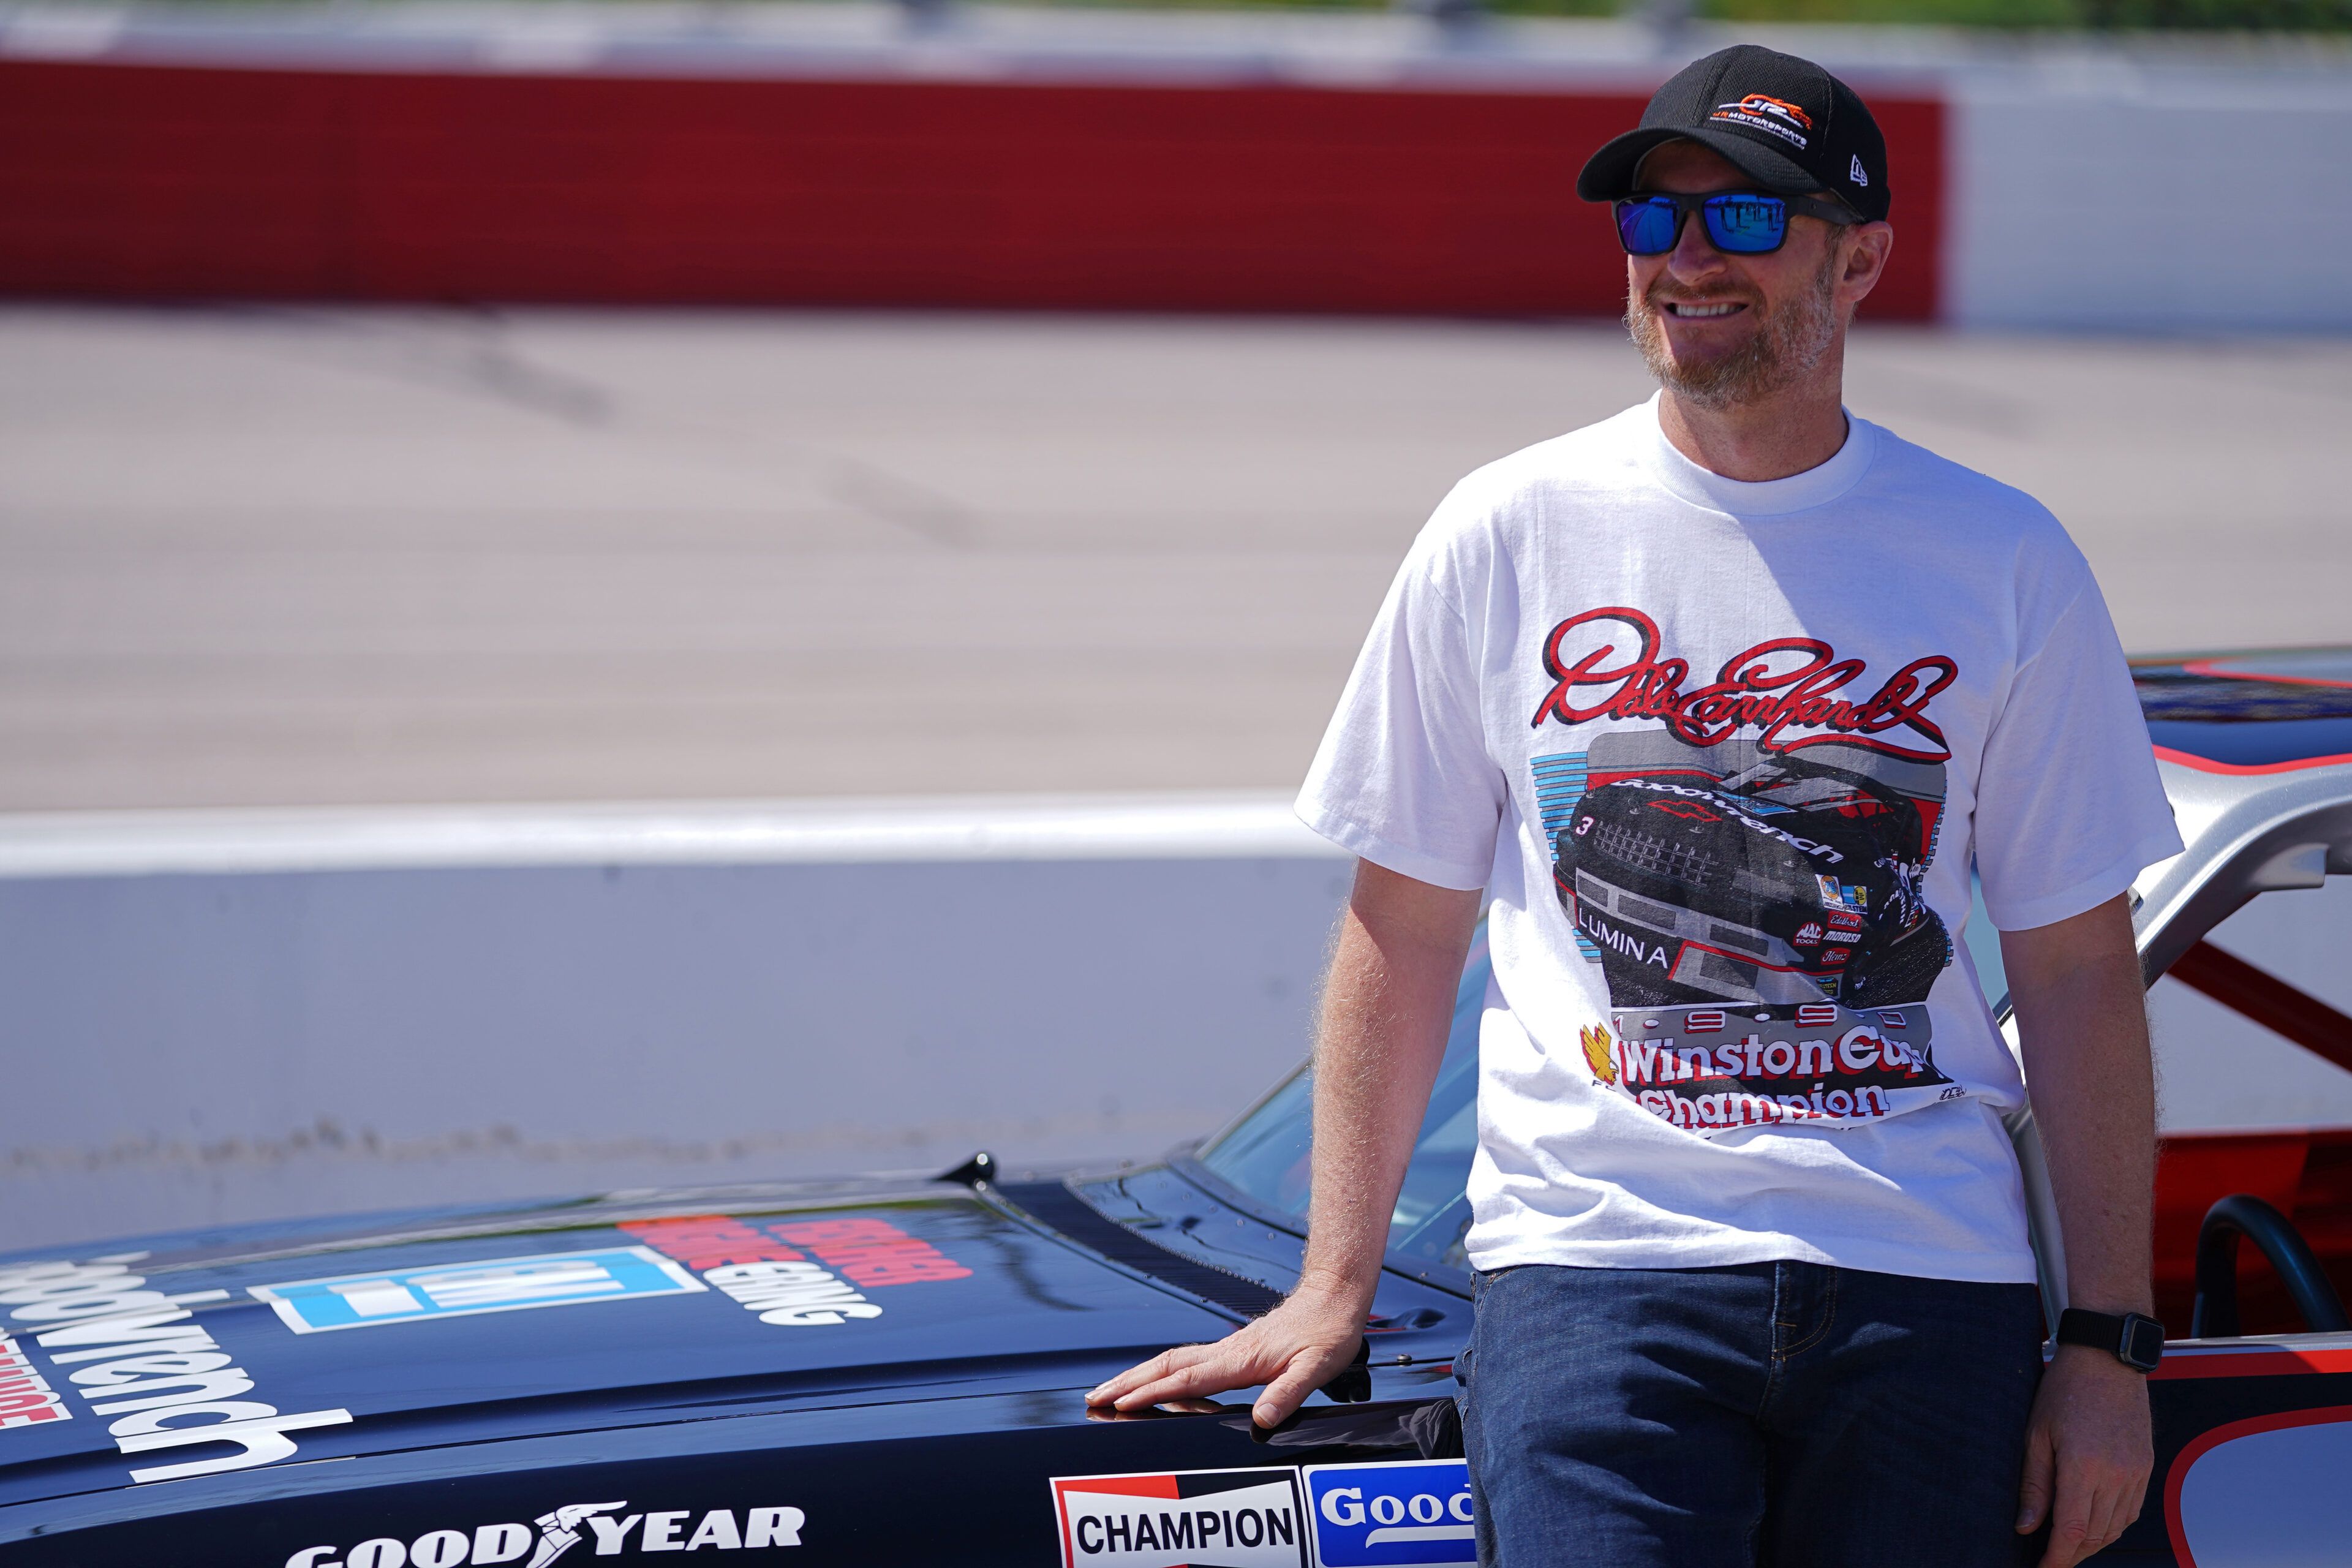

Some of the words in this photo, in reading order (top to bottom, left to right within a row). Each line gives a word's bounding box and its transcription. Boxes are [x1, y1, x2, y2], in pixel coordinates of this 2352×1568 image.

[1575, 816, 1594, 836] 3
[1823, 881, 1838, 895] 76
[1578, 908, 1669, 970] LUMINA
[1796, 923, 1822, 939] MAC
[1822, 930, 1862, 943] MOROSO
[1618, 1034, 1834, 1087] Winston
[1637, 1082, 1890, 1129] Champion
[284, 1505, 805, 1568] GOODYEAR
[1077, 1508, 1294, 1555] CHAMPION
